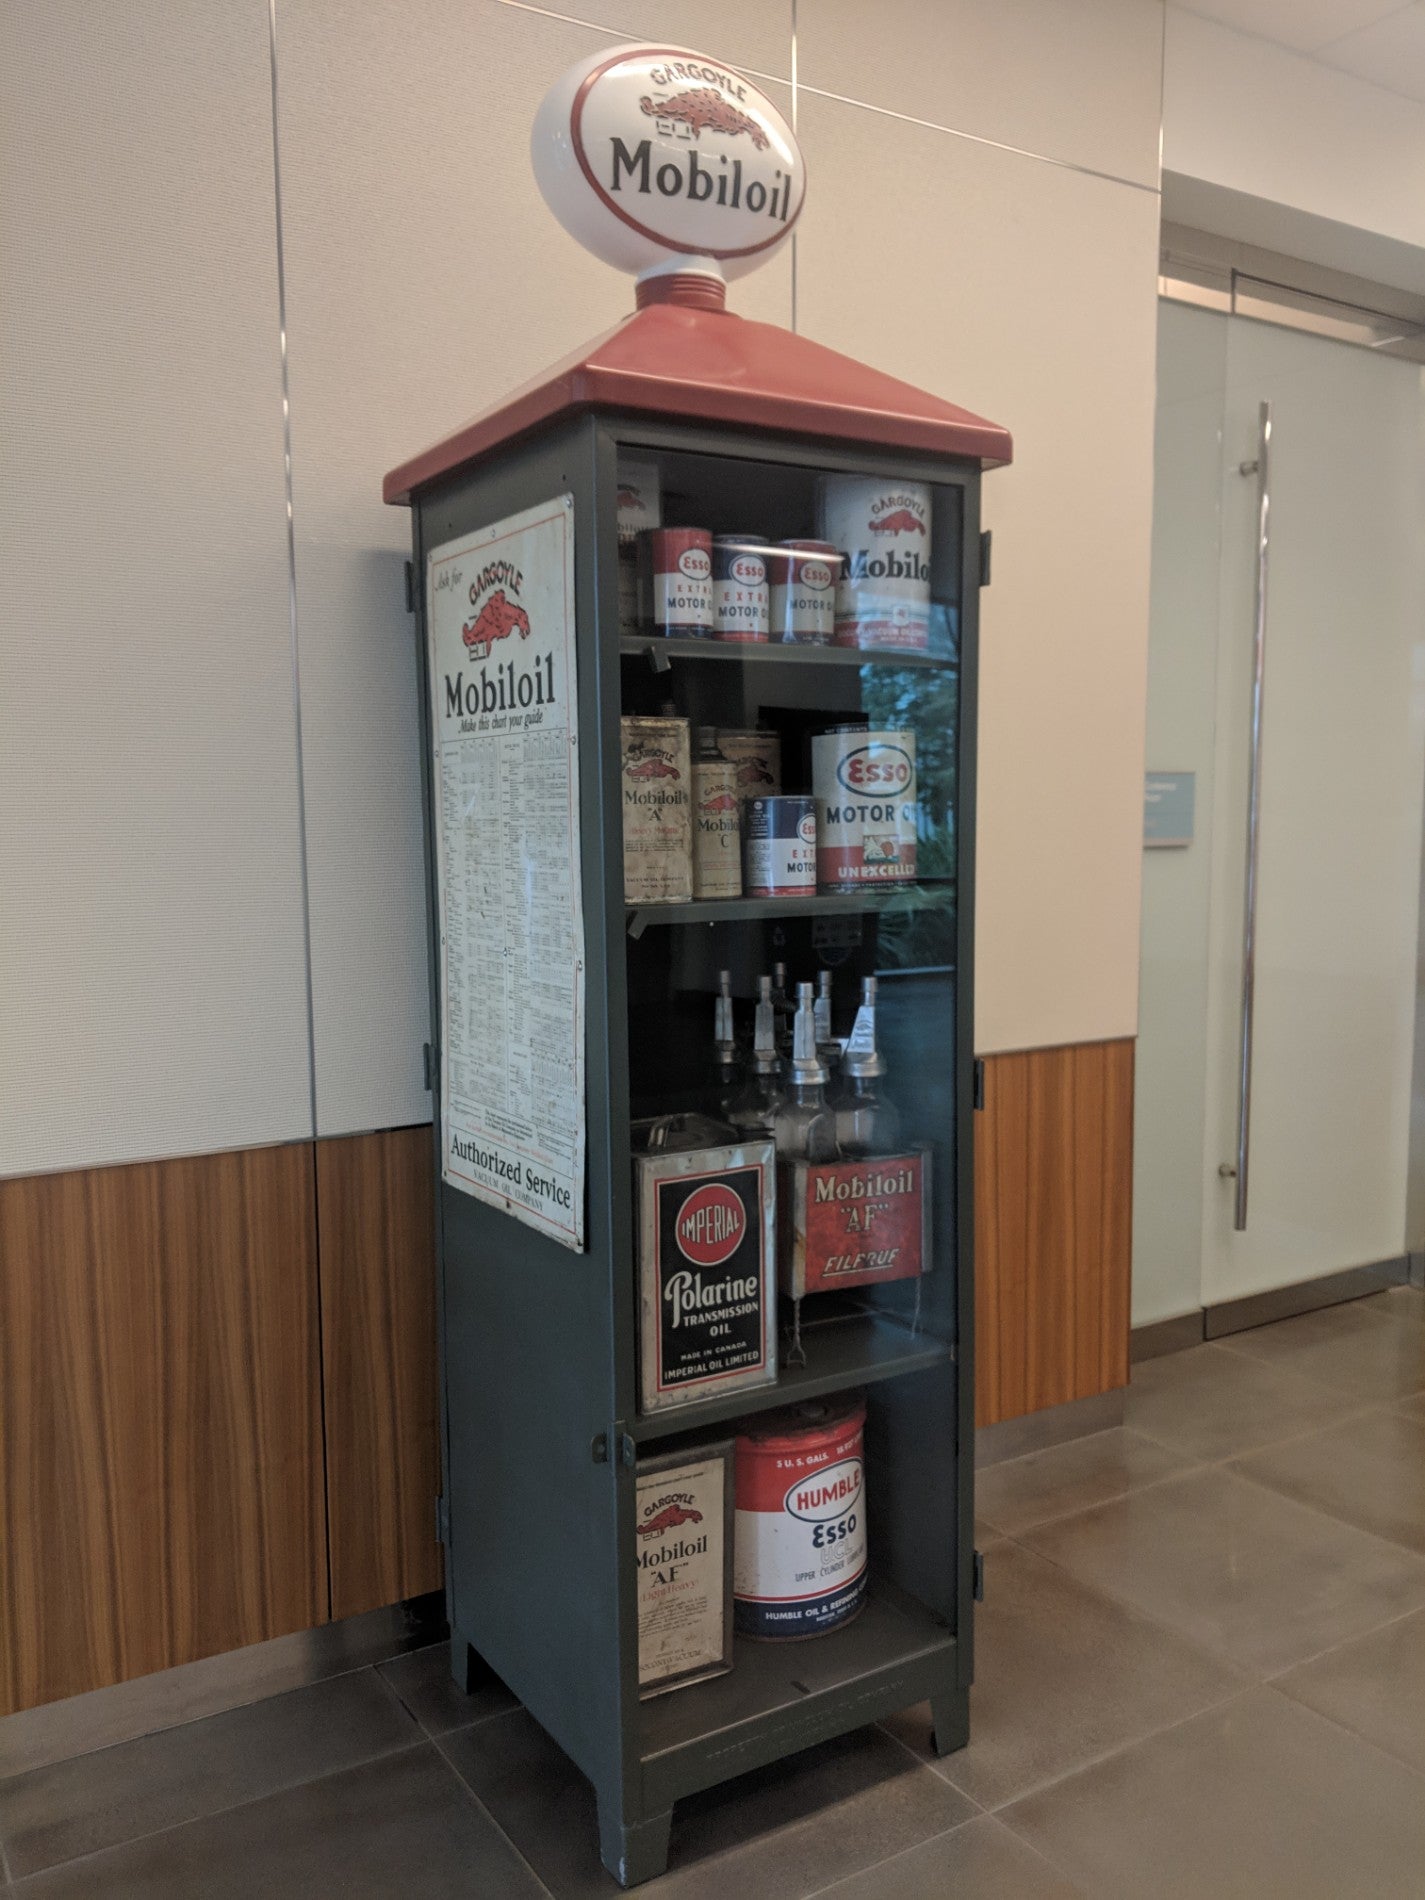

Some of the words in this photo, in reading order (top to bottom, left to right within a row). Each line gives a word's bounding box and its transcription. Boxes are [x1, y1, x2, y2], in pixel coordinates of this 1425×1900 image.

[650, 62, 748, 102] GARGOYLE
[609, 136, 792, 222] Mobiloil
[683, 556, 710, 571] Esso
[736, 563, 764, 577] Esso
[804, 567, 830, 582] Esso
[839, 549, 930, 582] Mobilo
[469, 561, 523, 606] GARGOYLE
[668, 597, 706, 609] MOTOR
[718, 606, 759, 618] MOTOR
[791, 598, 825, 611] MOTOR
[444, 651, 556, 718] Mobiloil
[458, 717, 477, 733] Make
[478, 715, 490, 731] this
[508, 713, 523, 732] your
[524, 708, 543, 729] guide
[848, 758, 908, 784] Esso
[624, 790, 683, 806] Mobiloil
[826, 805, 895, 825] MOTOR
[802, 823, 817, 835] Ess
[450, 1133, 522, 1185] Authorized
[526, 1168, 571, 1209] Service
[473, 1169, 499, 1189] VACUUM
[501, 1182, 512, 1196] OIL
[515, 1189, 543, 1212] COMPANY
[815, 1170, 913, 1203] Mobiloil
[681, 1204, 740, 1245] IMPERIAL
[664, 1270, 758, 1329] Polarine
[683, 1301, 759, 1327] TRANSMISSION
[709, 1323, 732, 1337] OIL
[680, 1351, 701, 1361] MADE
[715, 1341, 747, 1354] CANADA
[664, 1363, 708, 1380] IMPERIAL
[708, 1359, 723, 1370] OIL
[725, 1350, 759, 1366] LIMITED
[796, 1467, 860, 1511] HUMBLE
[643, 1492, 695, 1518] GARGOYLE
[812, 1513, 857, 1549] Esso
[635, 1535, 708, 1570] Mobiloil
[795, 1570, 816, 1583] UPPER
[820, 1558, 845, 1577] CYLINDER
[765, 1610, 803, 1620] HUMBLE
[805, 1607, 820, 1617] OIL
[821, 1604, 829, 1613] &
